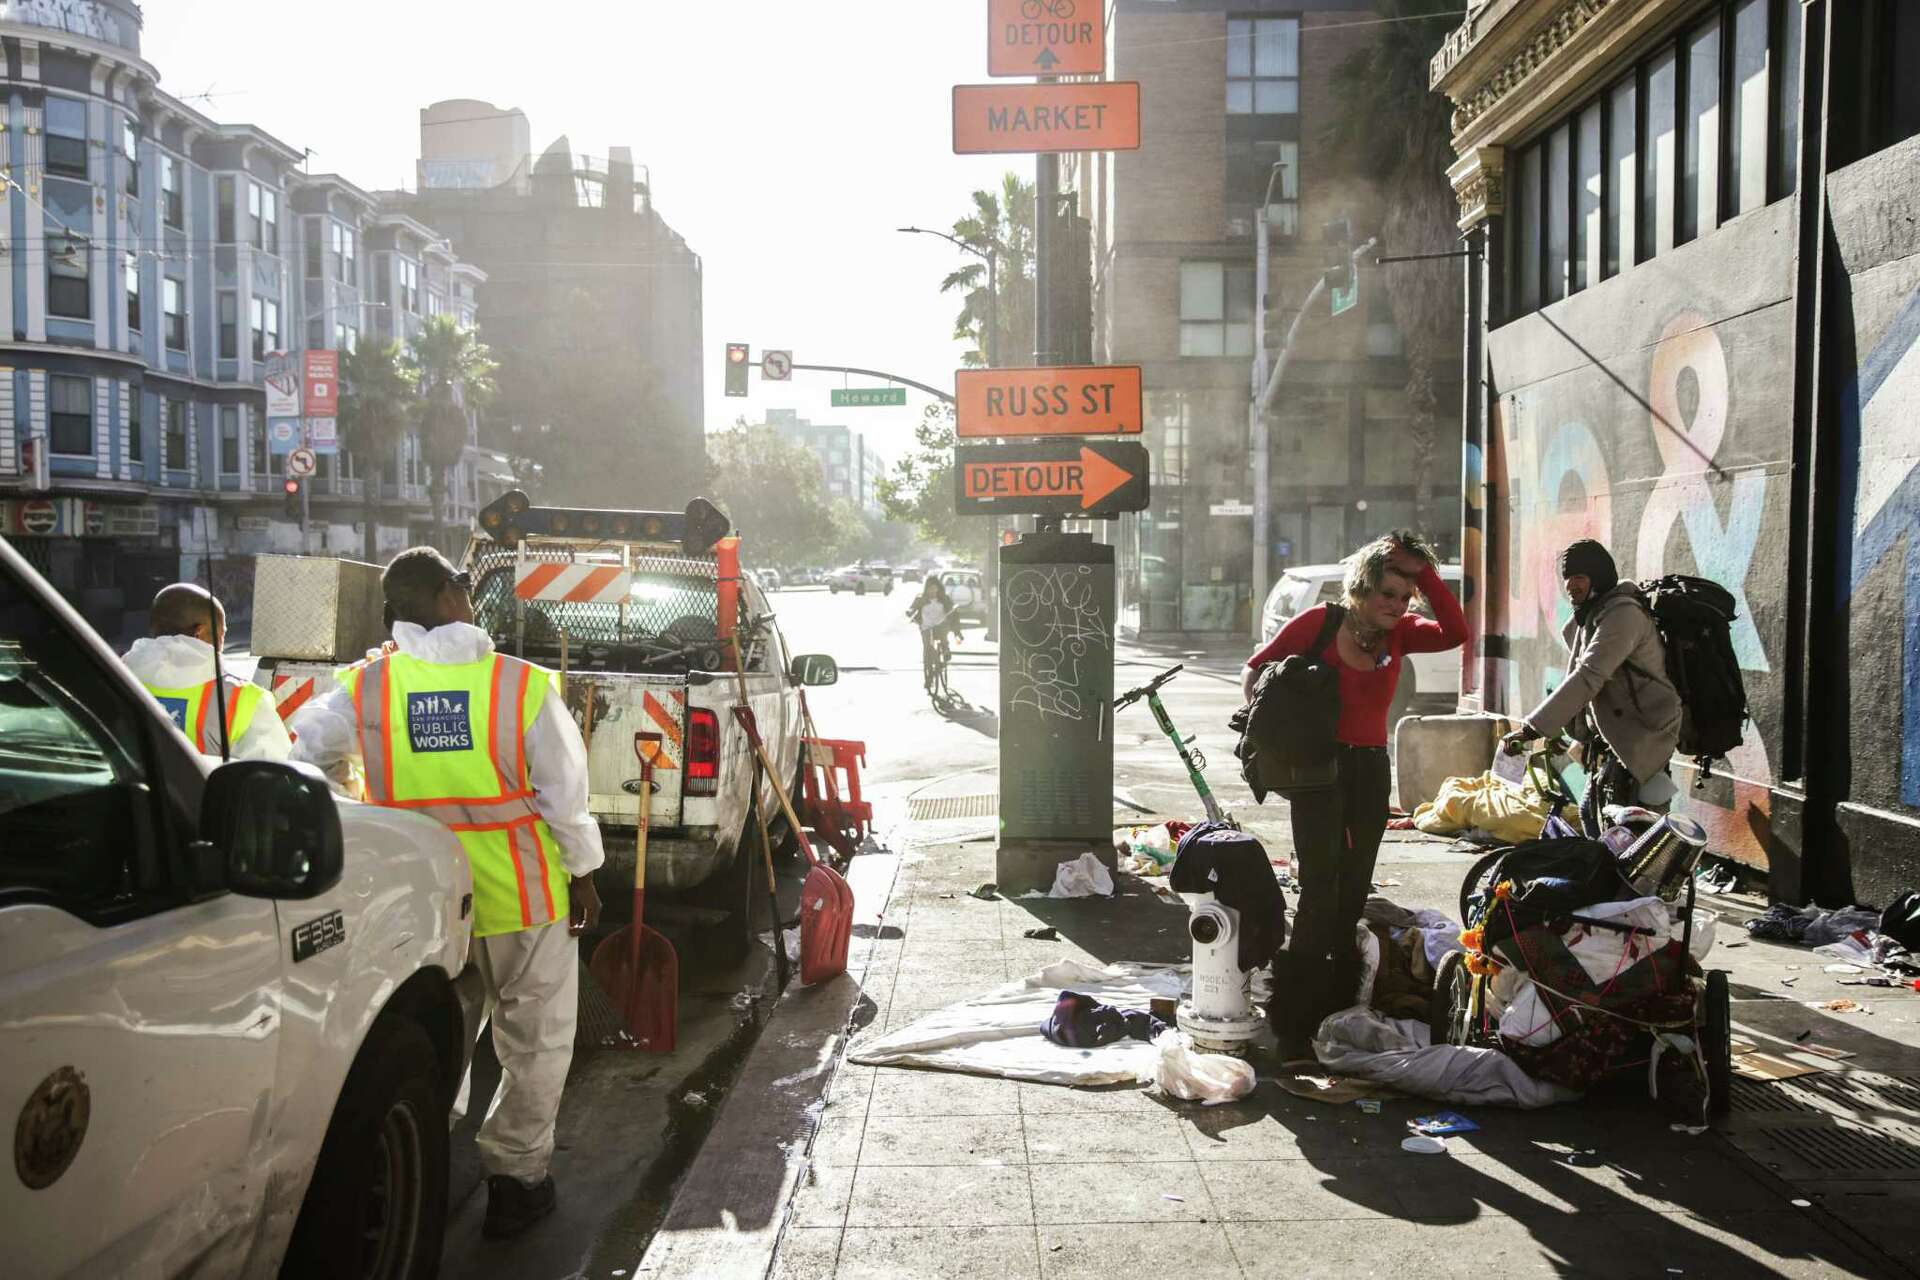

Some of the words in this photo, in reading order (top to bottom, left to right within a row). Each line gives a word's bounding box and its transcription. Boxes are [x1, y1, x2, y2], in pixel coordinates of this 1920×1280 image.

[1005, 22, 1093, 45] DETOUR
[987, 104, 1107, 132] MARKET
[840, 393, 897, 403] Howard
[986, 385, 1068, 416] RUSS
[1081, 384, 1115, 414] ST
[972, 466, 1084, 492] DETOUR
[412, 721, 467, 734] PUBLIC
[414, 734, 469, 748] WORKS
